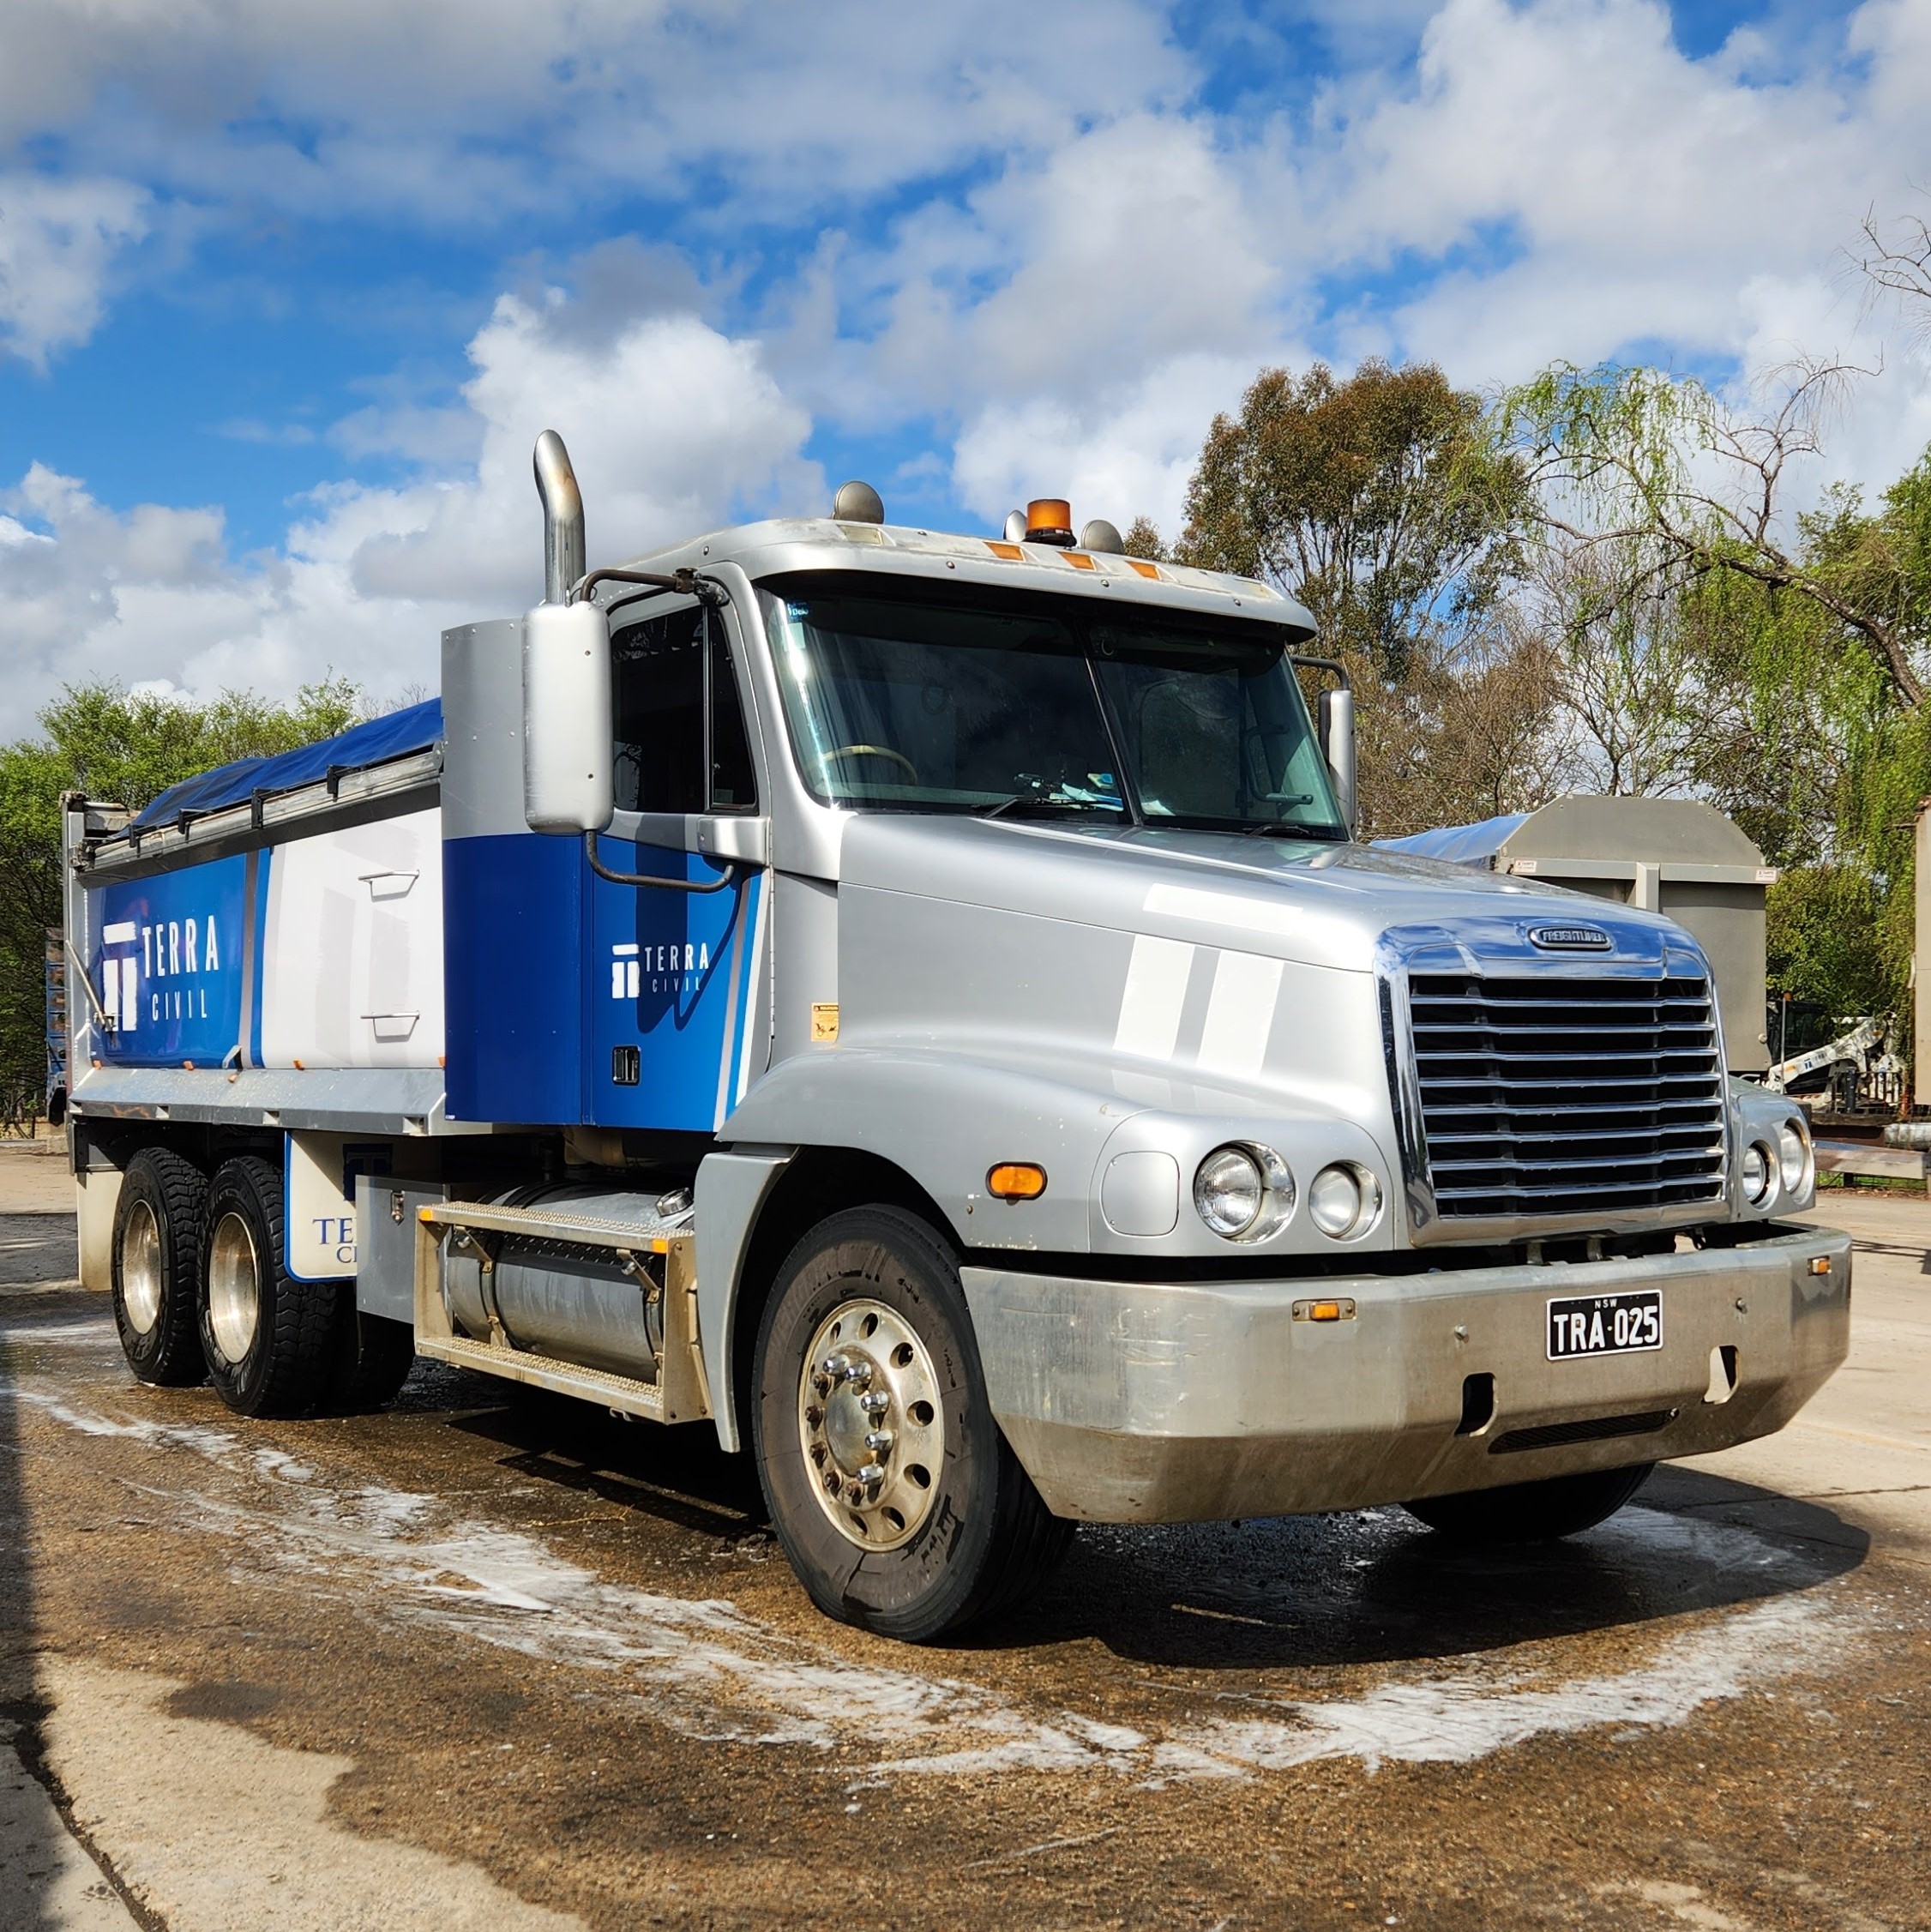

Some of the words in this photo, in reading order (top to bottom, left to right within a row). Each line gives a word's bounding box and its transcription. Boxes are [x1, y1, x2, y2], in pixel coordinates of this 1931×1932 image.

[142, 915, 219, 978] TERRA
[645, 942, 709, 972] TERRA
[652, 977, 700, 993] CIVIL
[152, 989, 208, 1021] CIVIL
[1594, 1298, 1618, 1309] NSW
